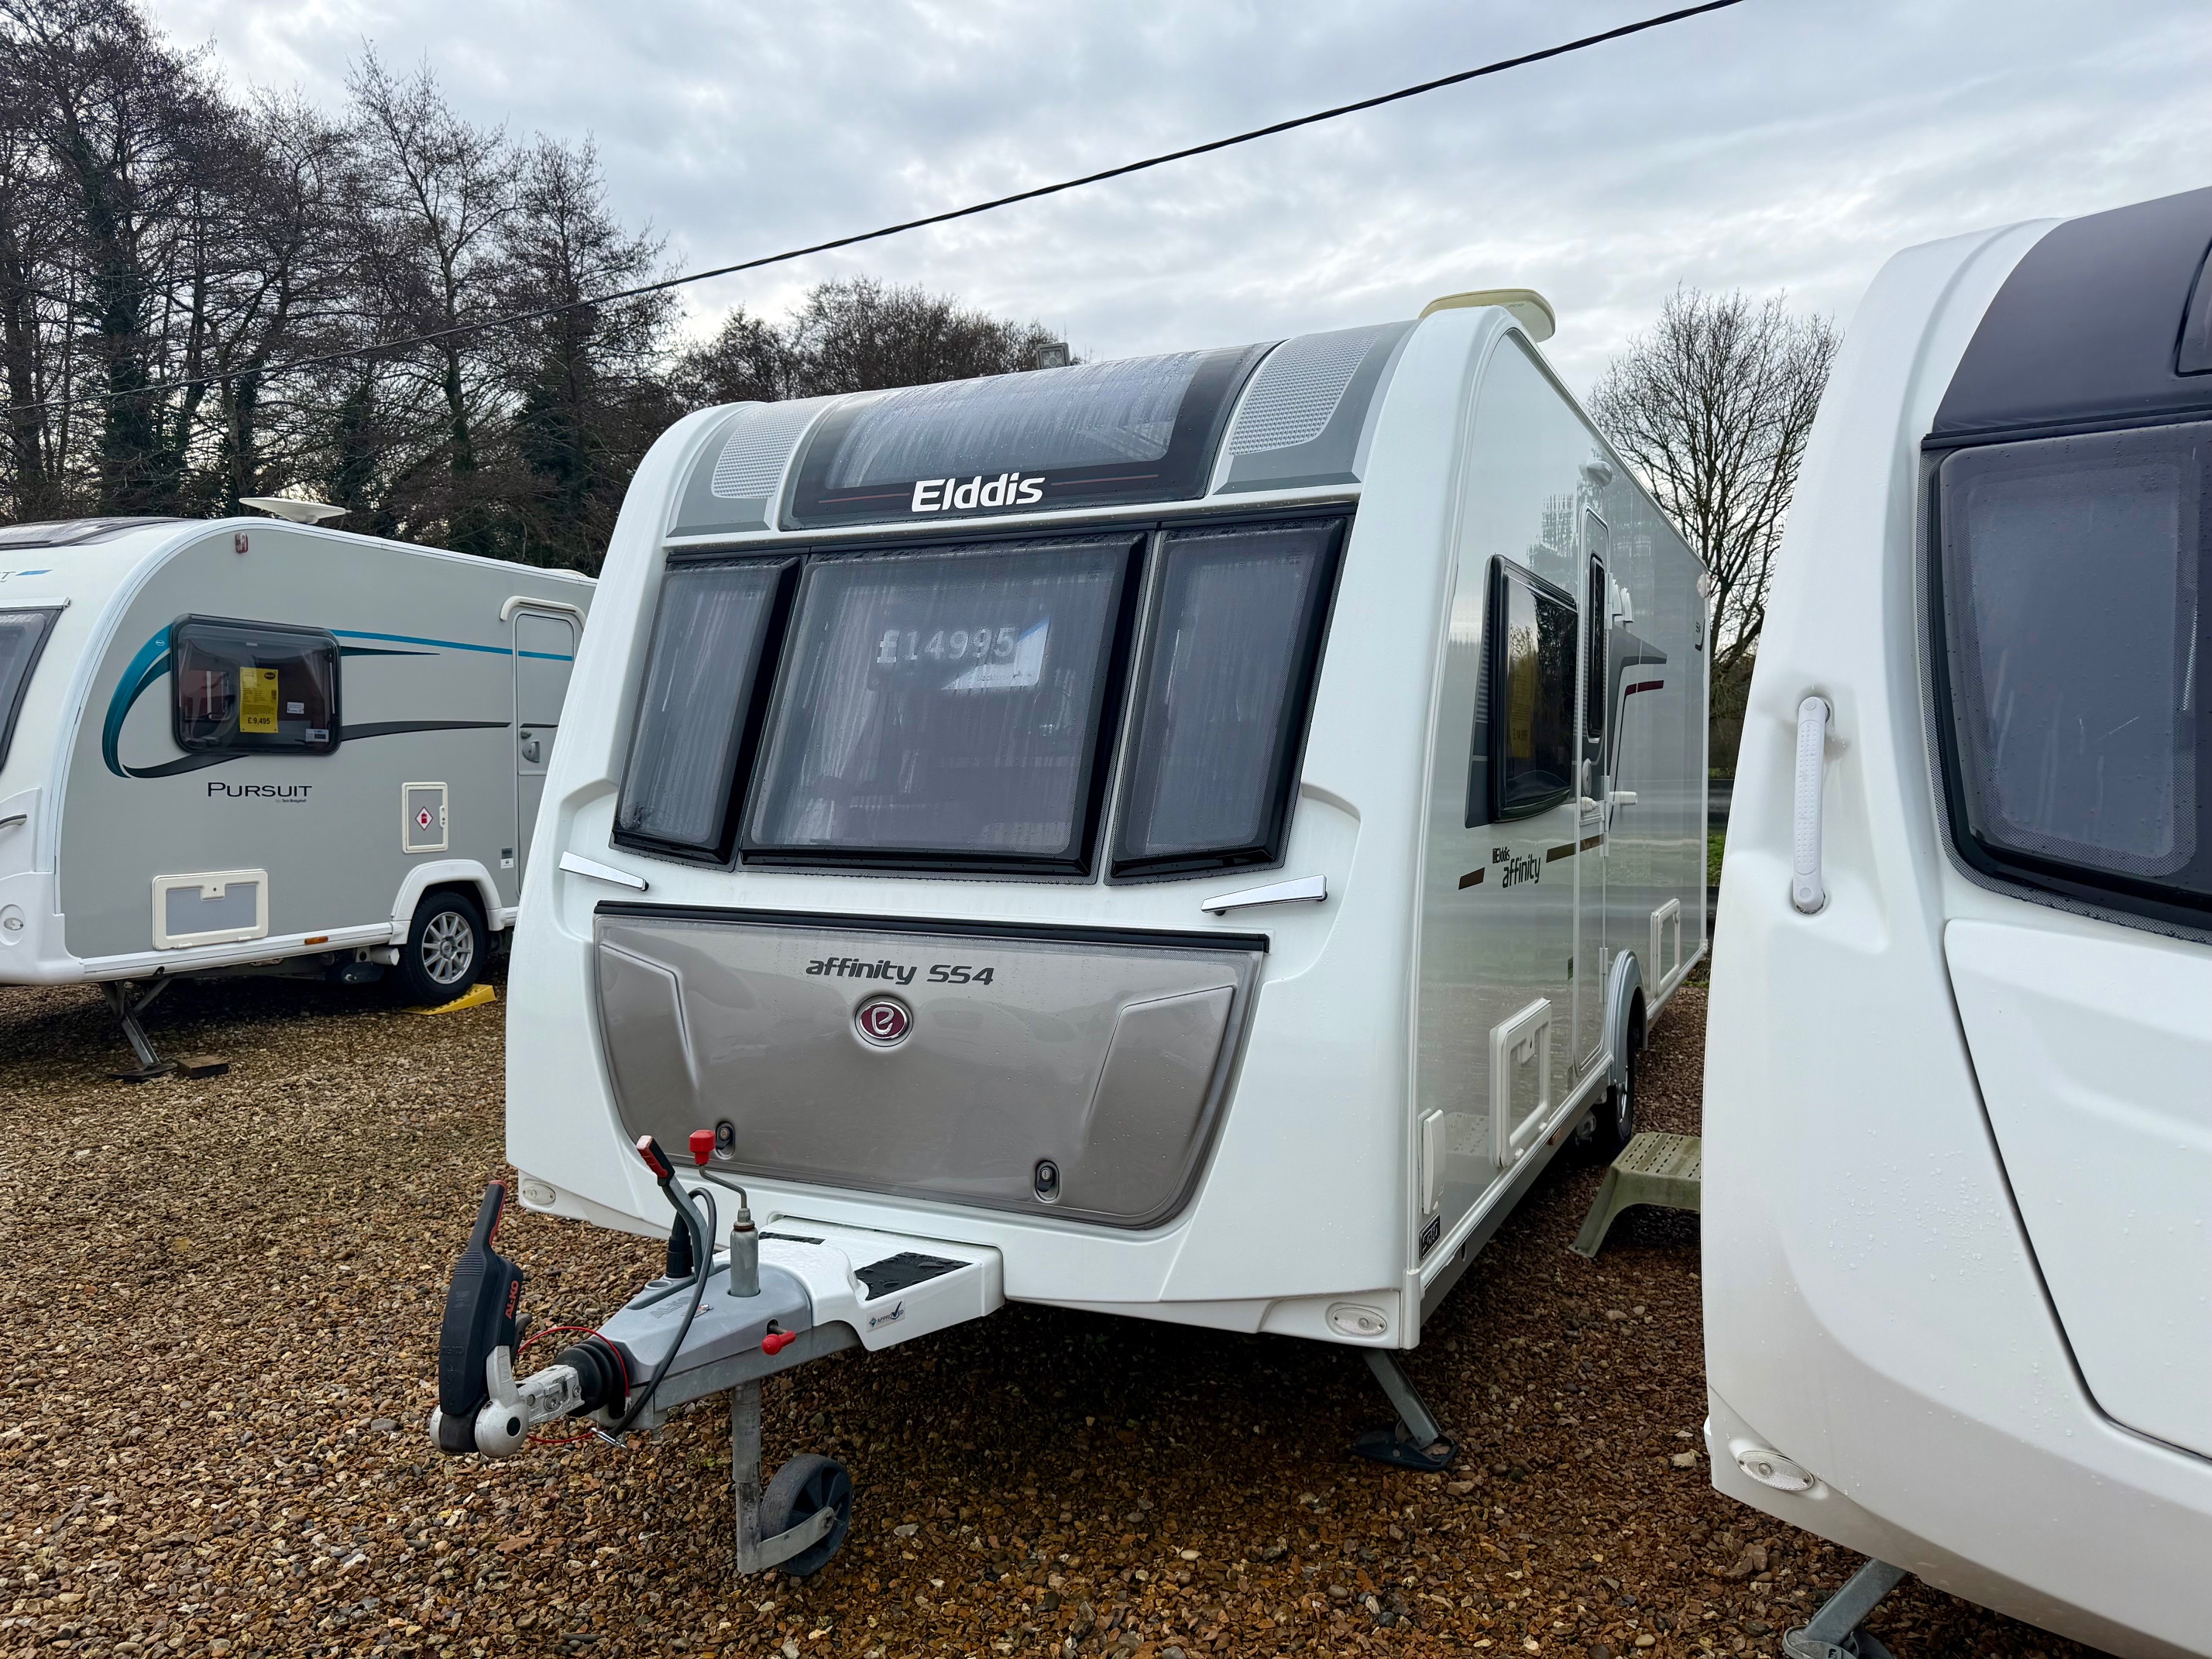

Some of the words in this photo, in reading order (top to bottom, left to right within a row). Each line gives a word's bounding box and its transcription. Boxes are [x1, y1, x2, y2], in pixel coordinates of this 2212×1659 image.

[912, 472, 1046, 513] Elddis
[877, 626, 1016, 664] £14995
[253, 717, 270, 726] 9,495
[208, 781, 312, 797] PURSUIT
[1503, 853, 1541, 889] affinity
[805, 957, 917, 985] affinity
[927, 964, 994, 985] SS4
[505, 1280, 520, 1320] AL-KO
